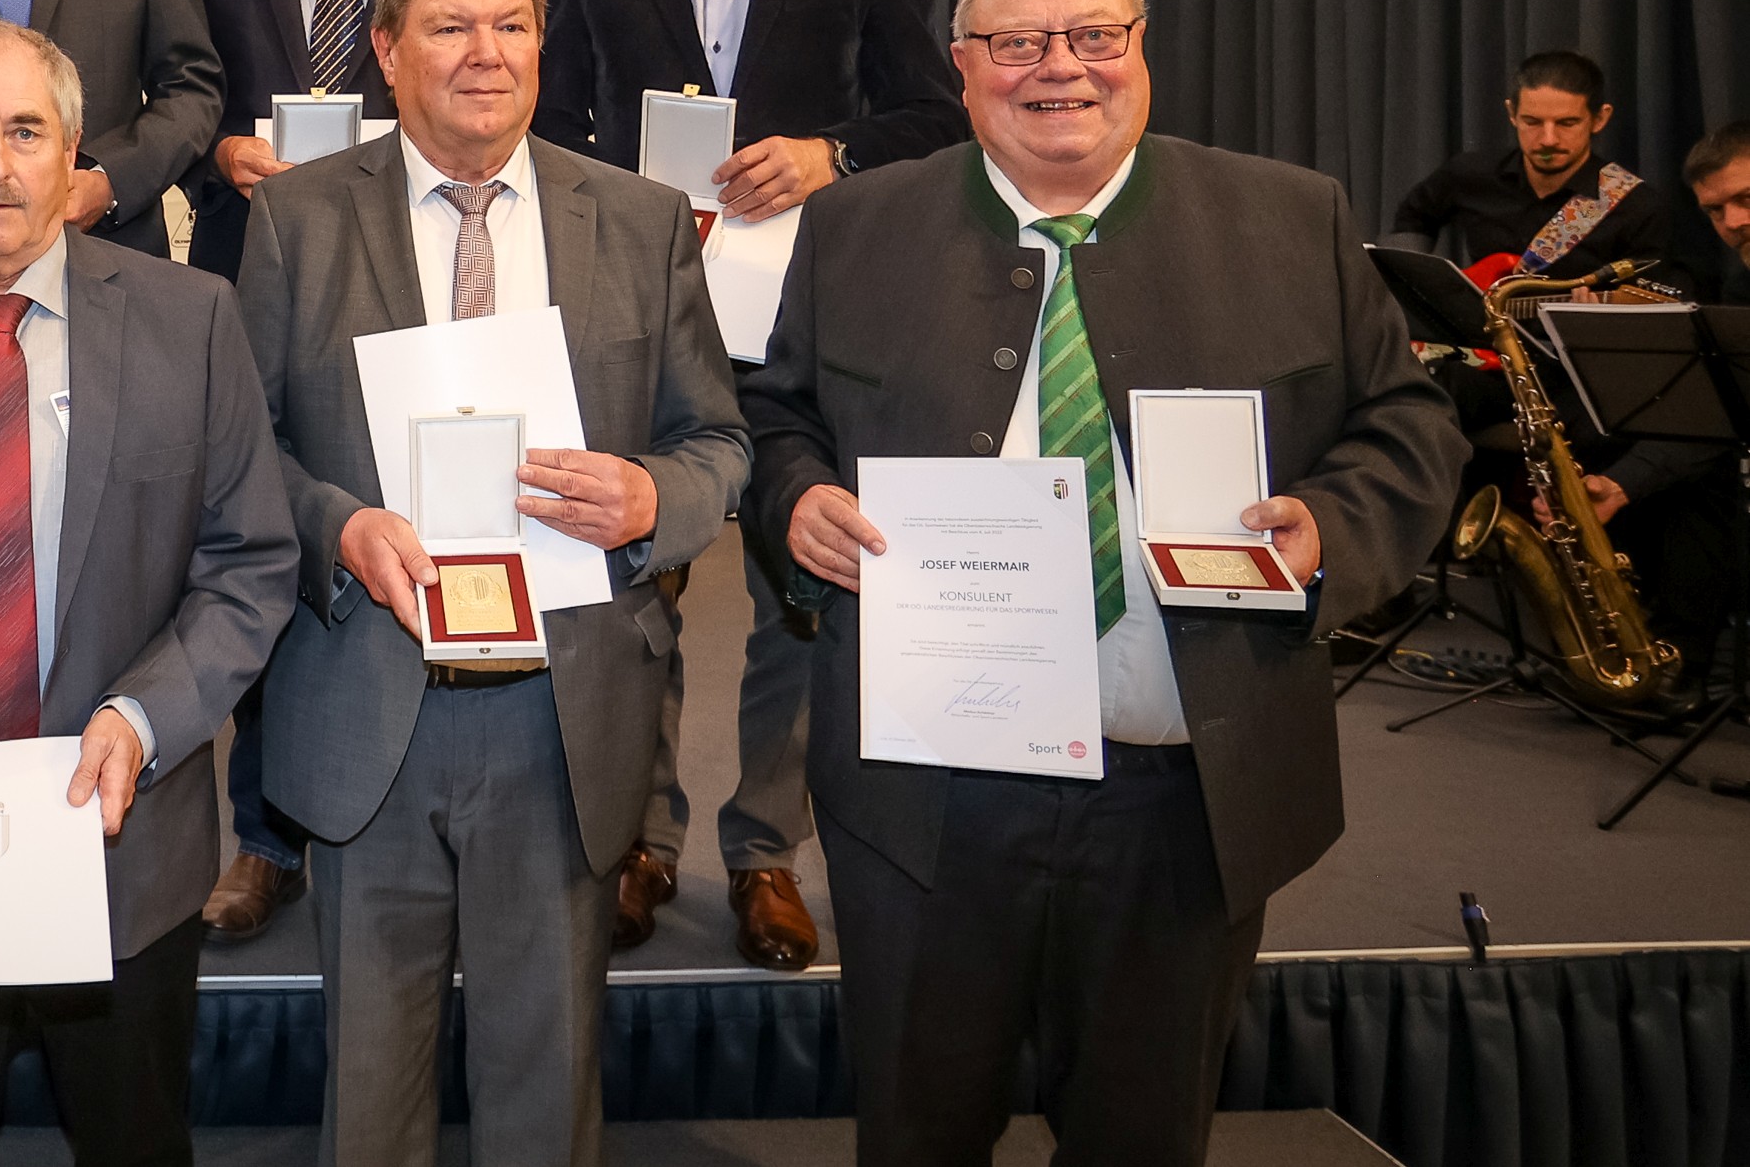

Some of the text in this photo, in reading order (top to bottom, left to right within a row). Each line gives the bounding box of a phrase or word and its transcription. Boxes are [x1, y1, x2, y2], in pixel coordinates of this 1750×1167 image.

[919, 560, 1030, 572] JOSEF WEIERMAIR
[939, 591, 1013, 603] KONSULENT
[1028, 742, 1062, 755] Sport
